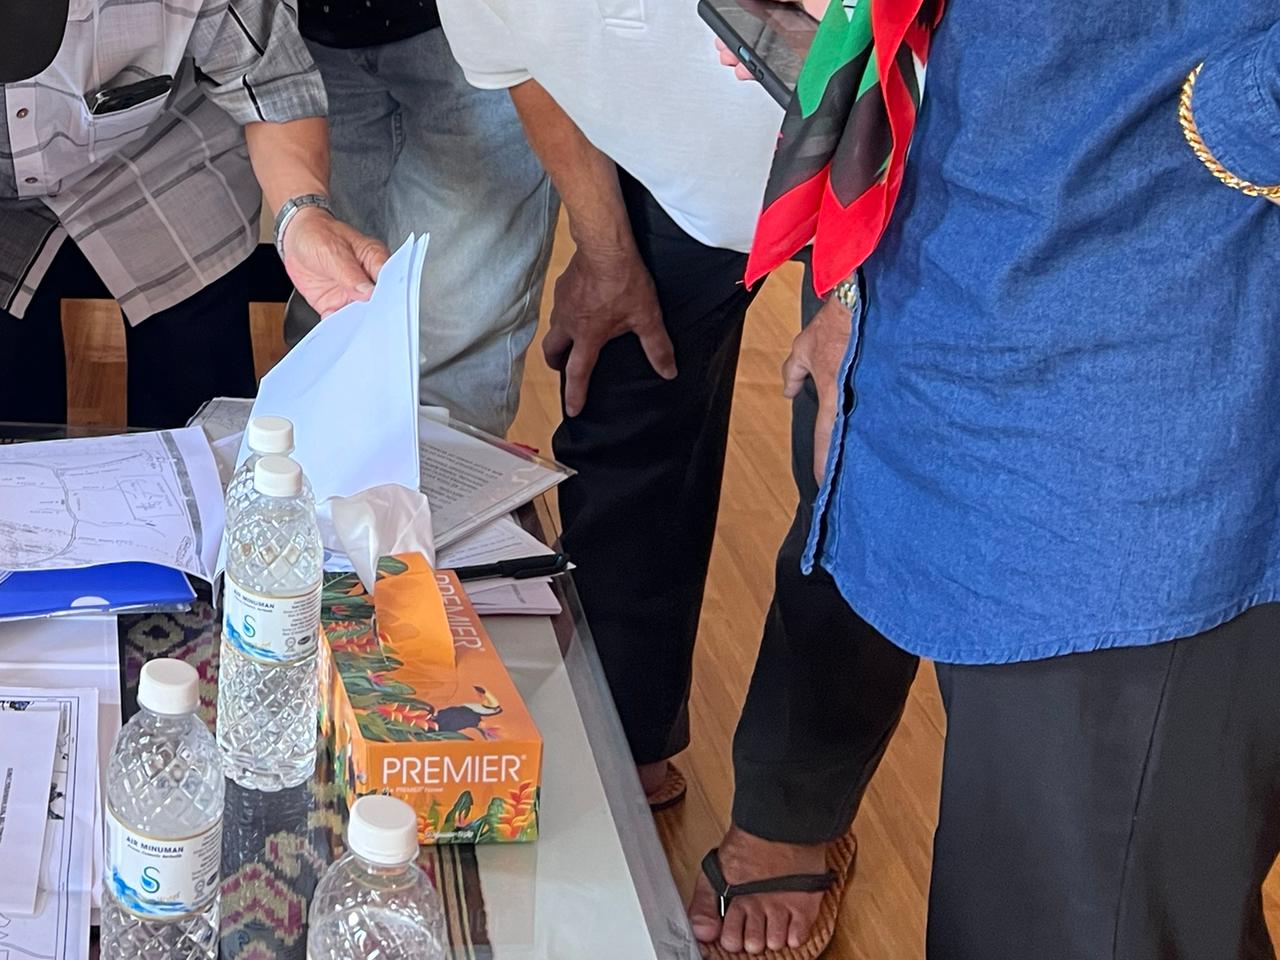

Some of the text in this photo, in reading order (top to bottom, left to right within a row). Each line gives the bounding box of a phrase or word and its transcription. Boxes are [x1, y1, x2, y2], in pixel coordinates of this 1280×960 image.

[383, 754, 522, 785] PREMIER
[126, 836, 138, 847] AIR
[140, 843, 184, 854] MINUMAN
